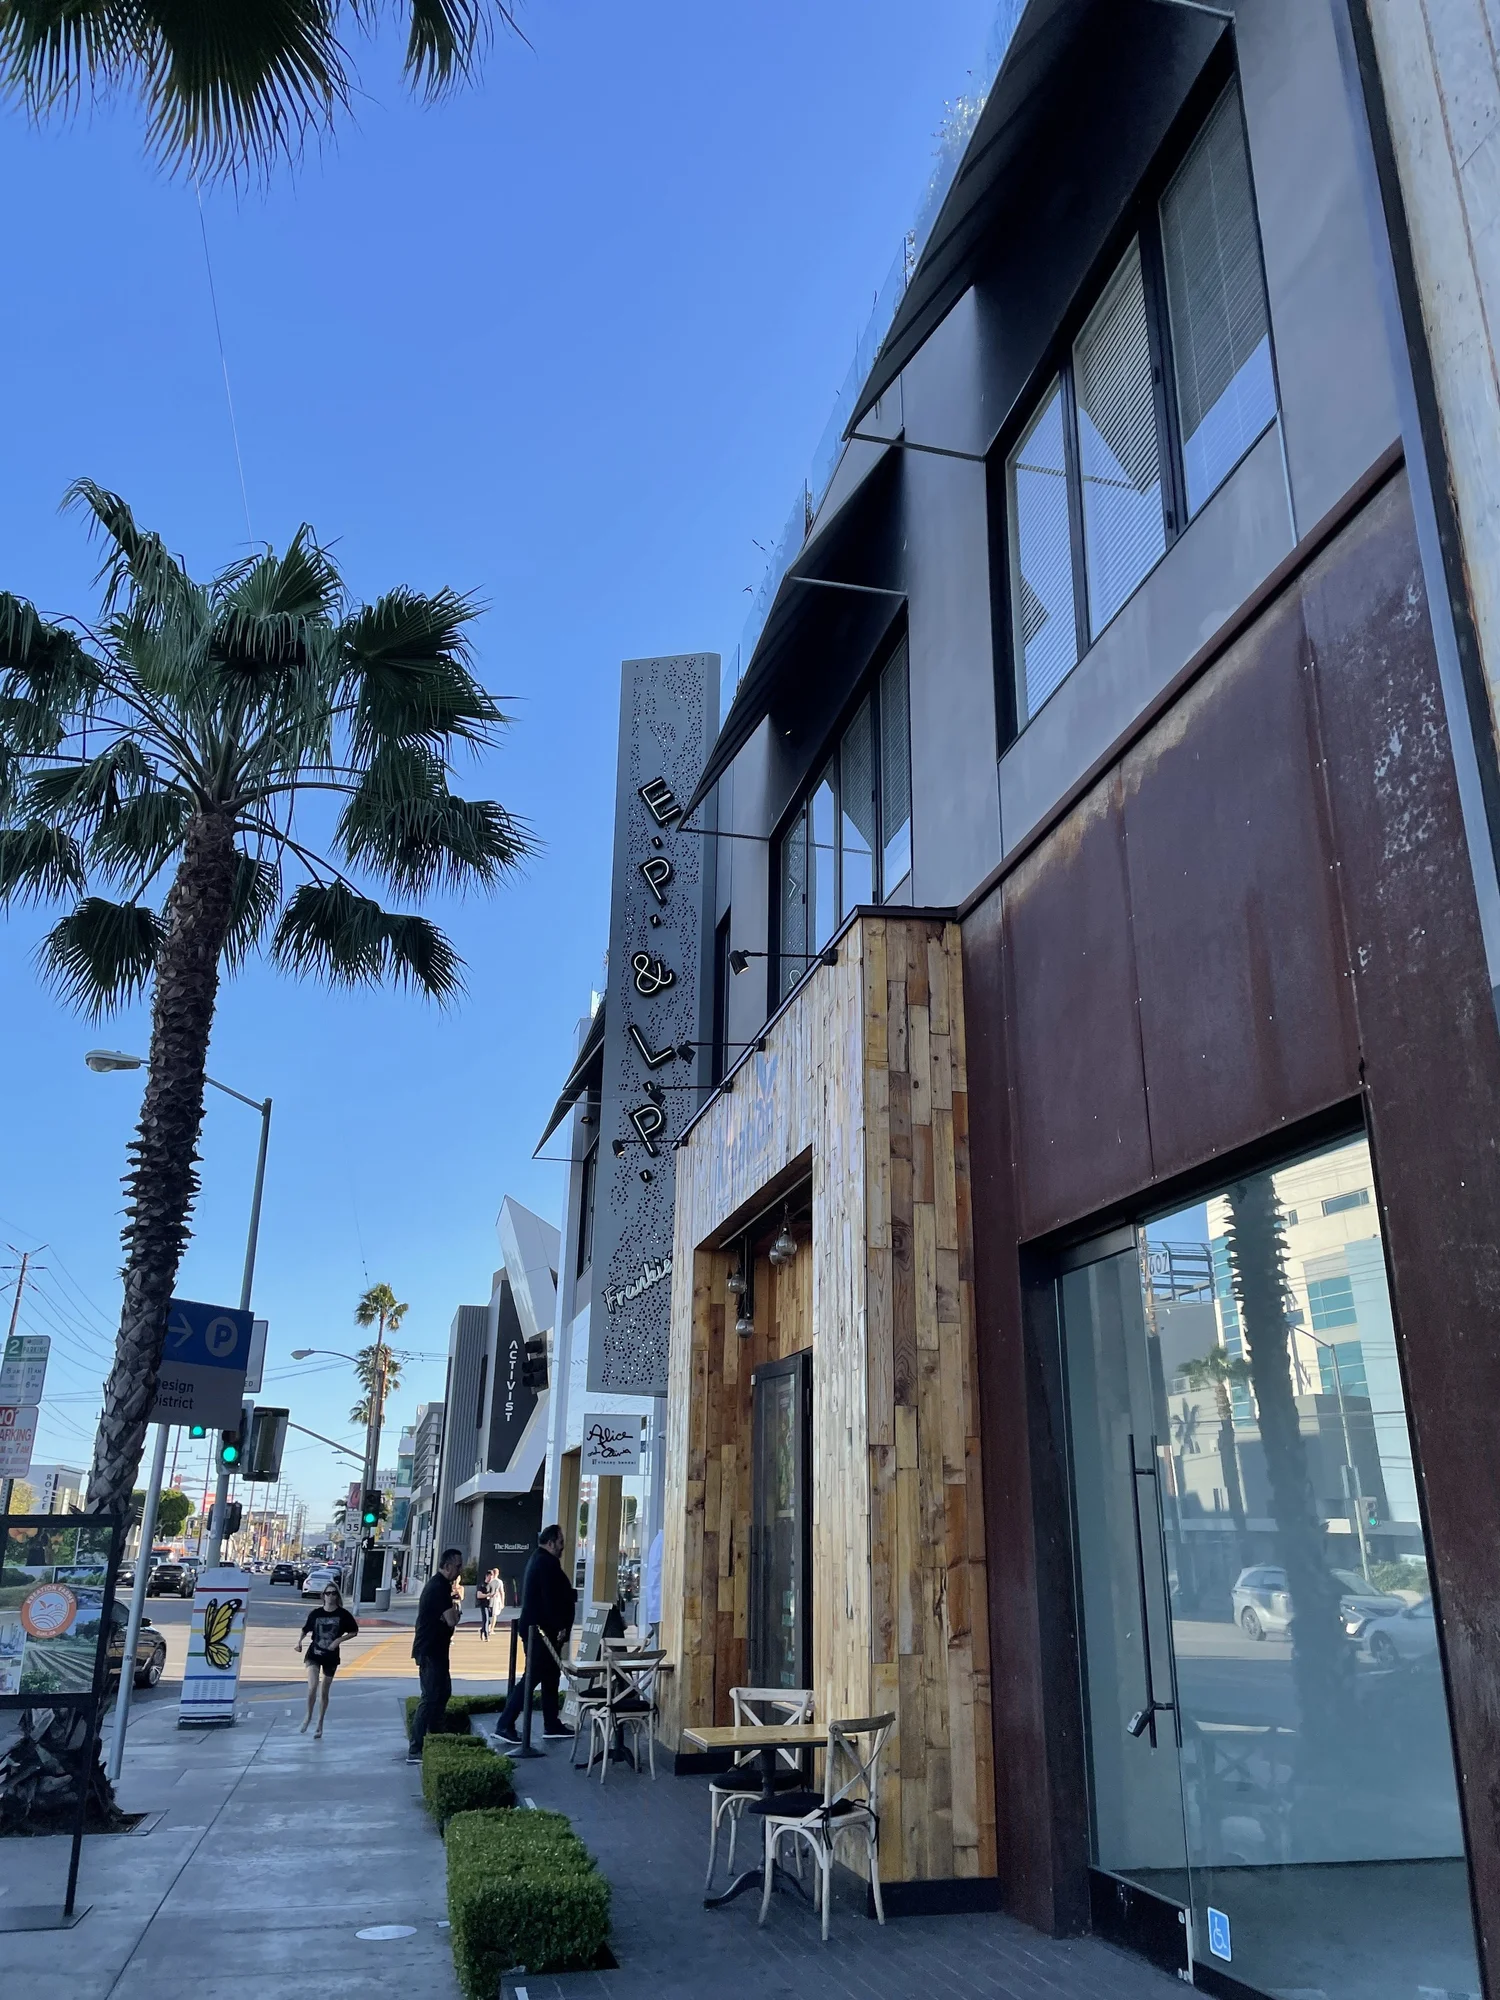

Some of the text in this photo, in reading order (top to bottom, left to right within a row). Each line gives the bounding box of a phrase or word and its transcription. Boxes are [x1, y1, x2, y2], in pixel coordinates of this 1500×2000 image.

[631, 950, 677, 998] &
[9, 1340, 20, 1354] 2
[504, 1339, 519, 1422] ACTIVIST
[0, 1428, 32, 1442] ARKING
[586, 1424, 633, 1446] Alice
[346, 1523, 360, 1532] 35
